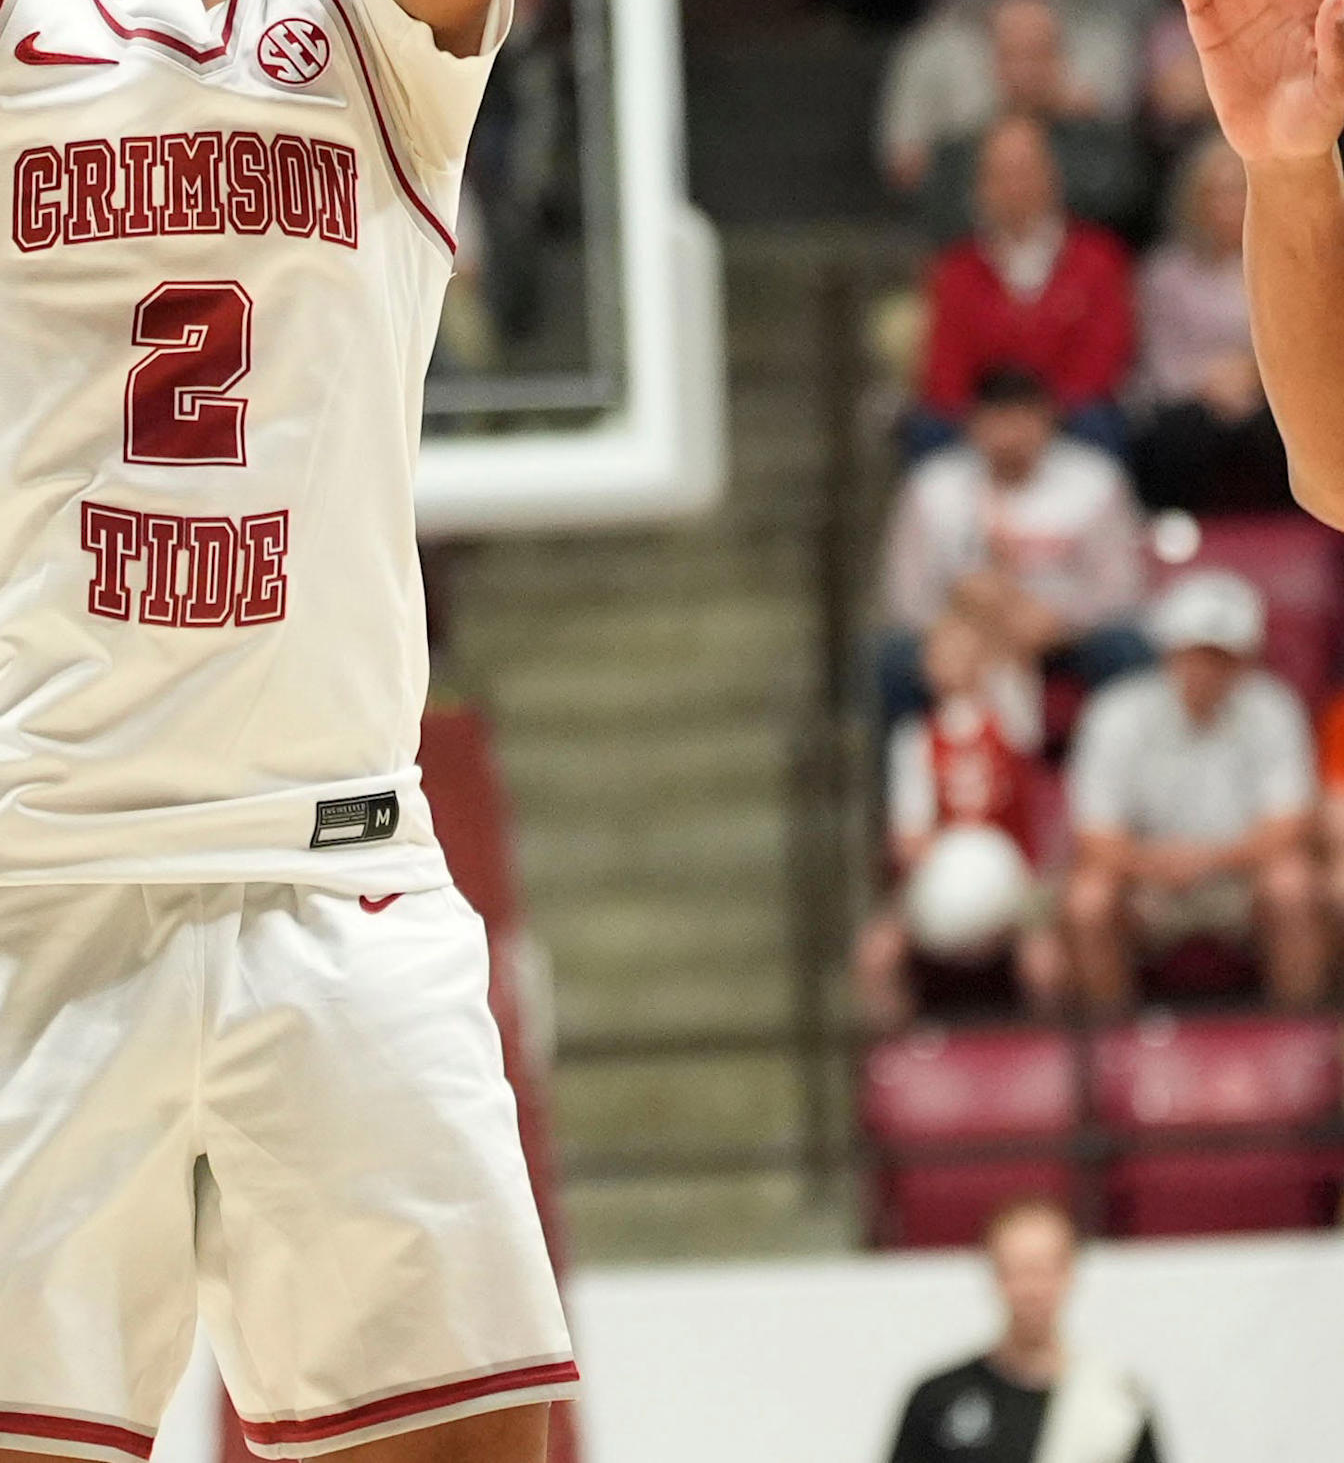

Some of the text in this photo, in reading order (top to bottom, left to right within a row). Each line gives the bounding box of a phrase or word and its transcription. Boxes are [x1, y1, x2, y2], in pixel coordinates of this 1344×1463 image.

[260, 19, 329, 83] SEC
[12, 131, 358, 253] CRIMSON
[123, 280, 253, 467] 2
[81, 500, 289, 628] TIDE
[375, 807, 391, 828] M
